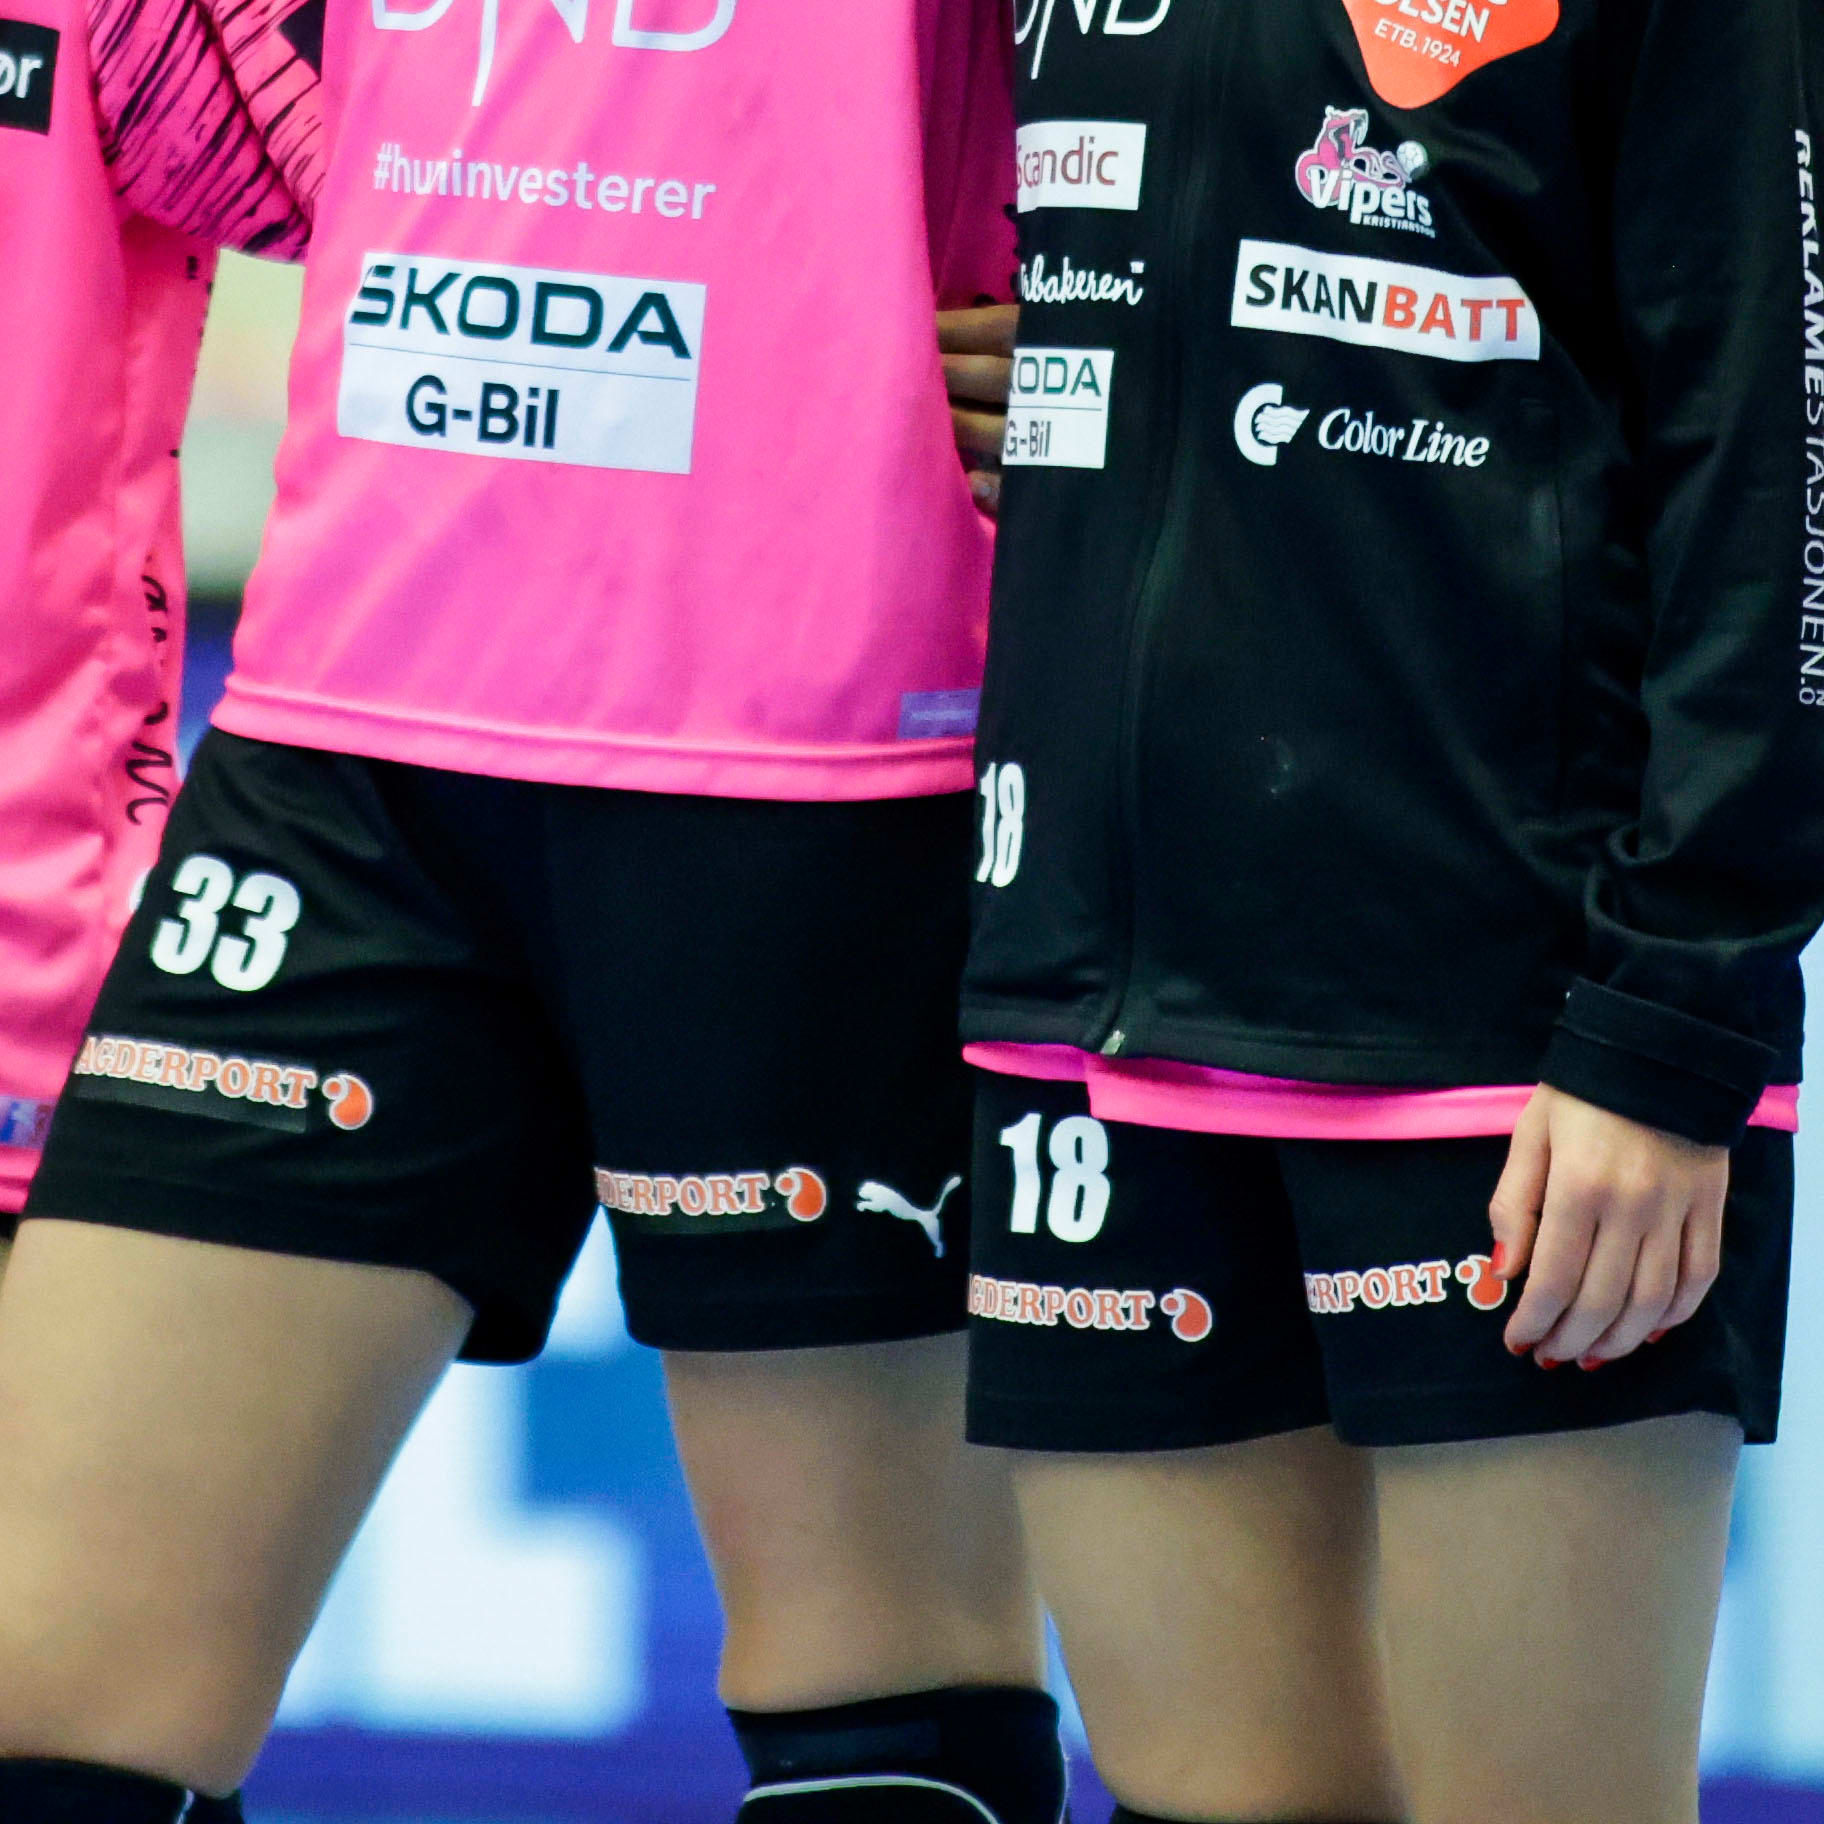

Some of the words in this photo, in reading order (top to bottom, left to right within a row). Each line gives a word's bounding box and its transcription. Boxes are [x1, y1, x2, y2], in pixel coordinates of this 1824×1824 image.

[1305, 163, 1434, 226] Vipers
[1245, 264, 1526, 342] SKANBATT
[405, 373, 560, 450] G-Bil
[975, 761, 1025, 888] 18
[149, 854, 300, 992] 33
[998, 1112, 1110, 1243] 18
